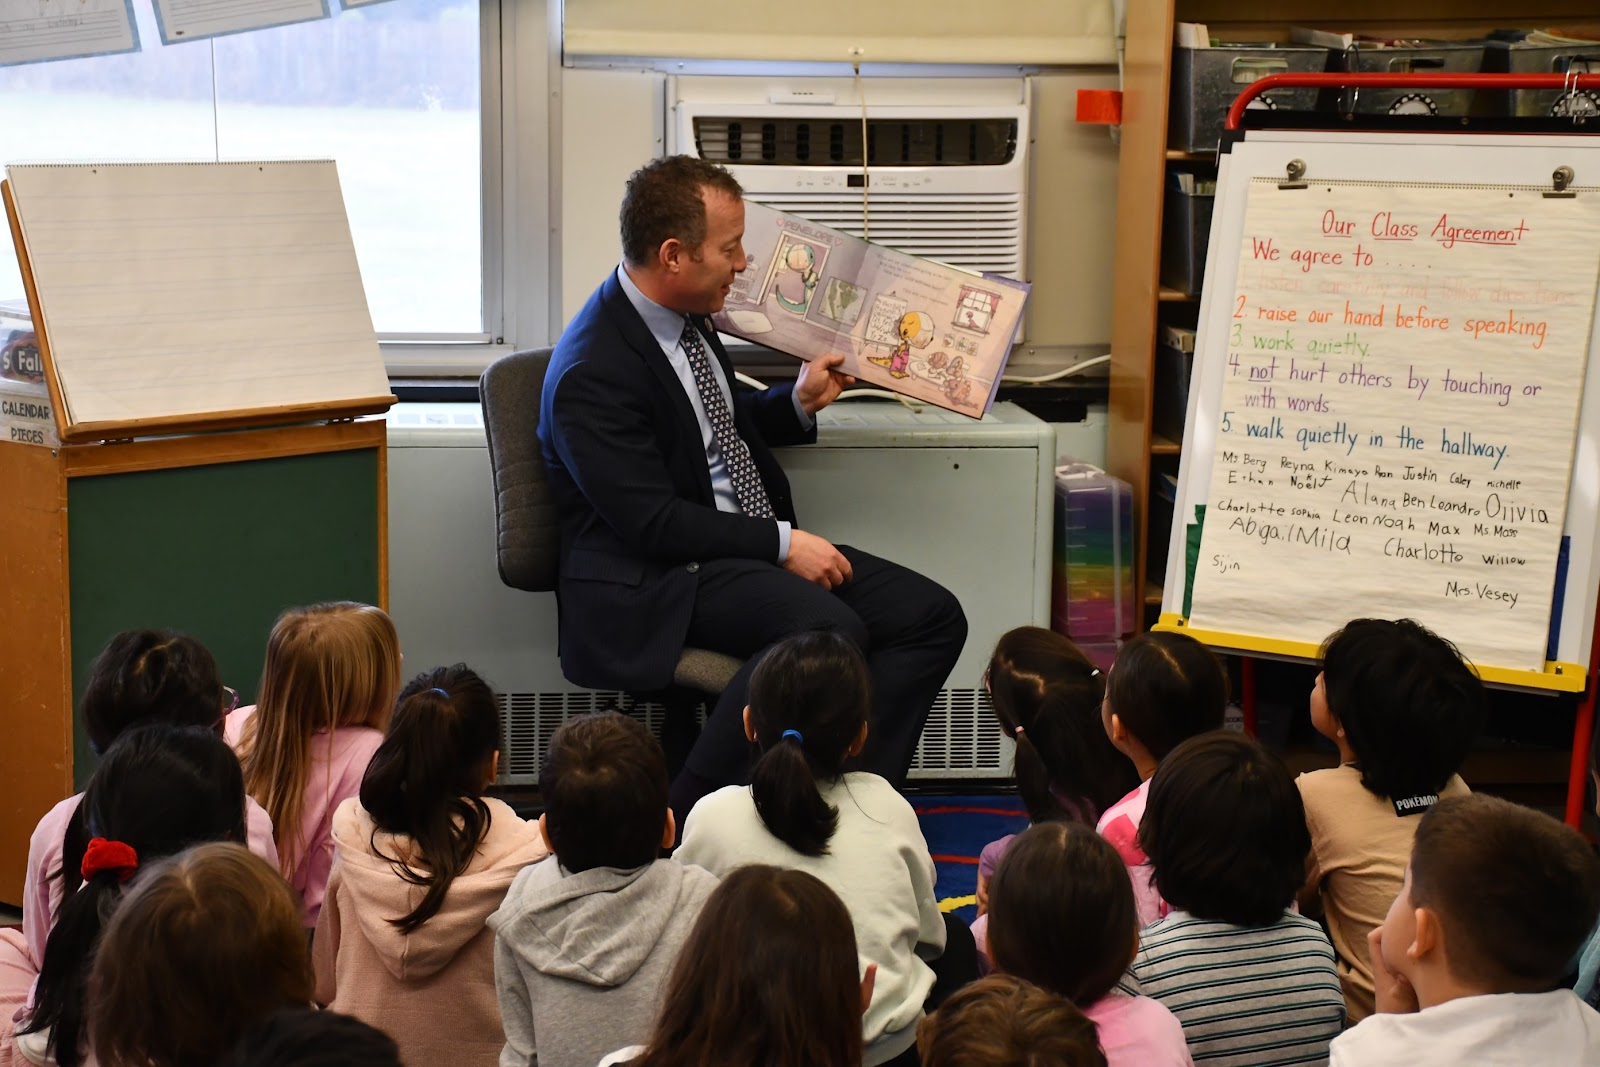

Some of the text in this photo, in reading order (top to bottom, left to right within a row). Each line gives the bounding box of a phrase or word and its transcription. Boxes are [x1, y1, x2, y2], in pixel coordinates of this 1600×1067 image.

[784, 220, 835, 244] PENELOPE
[1322, 209, 1530, 249] Our Class Agreement
[1252, 236, 1281, 261] We
[1290, 249, 1343, 273] agree
[1352, 244, 1374, 267] to
[1258, 306, 1297, 322] raise
[1308, 310, 1334, 324] our
[1343, 300, 1385, 328] hand
[1395, 303, 1450, 330] before
[1253, 329, 1294, 351] work
[1249, 356, 1280, 383] not
[1289, 358, 1330, 384] hurt
[1338, 362, 1393, 388] others
[1408, 365, 1430, 401] by
[1441, 368, 1512, 407] touching
[1522, 384, 1543, 397] or
[2, 401, 50, 419] CALENDAR
[1244, 386, 1277, 409] with
[11, 427, 44, 444] PIECES
[1246, 416, 1284, 439] walk
[1296, 421, 1358, 457] quietly
[1369, 429, 1384, 448] in
[1396, 424, 1425, 450] the
[1243, 452, 1268, 474] Berg
[1280, 455, 1316, 474] Reyna
[1402, 465, 1438, 483] Justin
[1228, 470, 1275, 486] Ethan
[1340, 479, 1397, 511] Alana
[1402, 492, 1426, 509] Ben
[1430, 494, 1481, 517] Leandro
[1217, 498, 1286, 517] Charlotte
[1332, 508, 1369, 525] Leon
[1372, 512, 1416, 531] Noah
[1428, 520, 1461, 537] Max
[1211, 553, 1241, 575] Sijin
[1444, 581, 1520, 610] Mrs. Vesey
